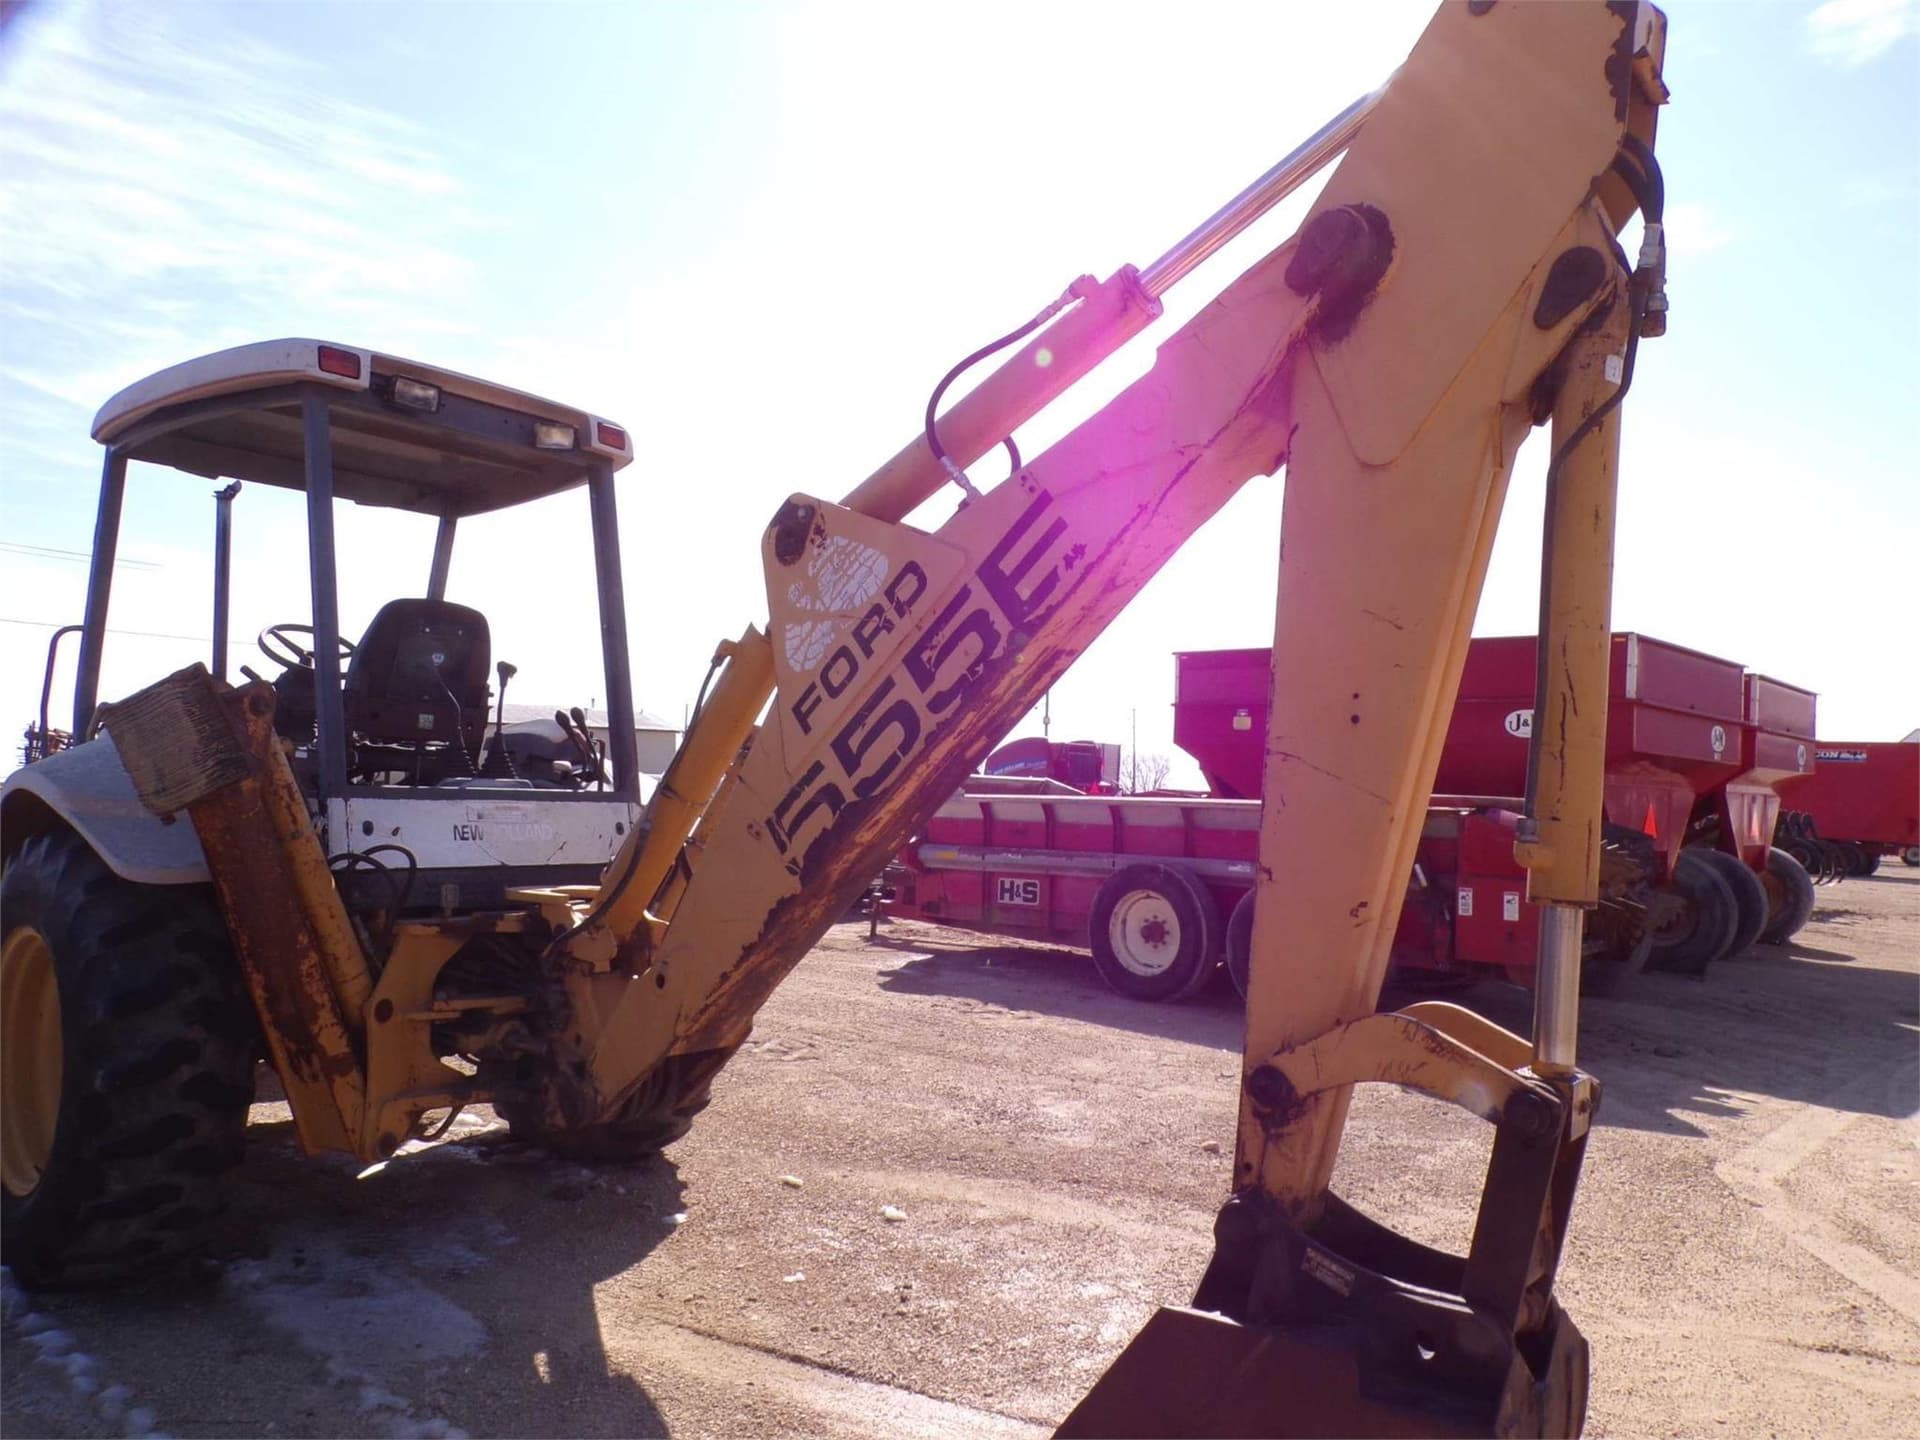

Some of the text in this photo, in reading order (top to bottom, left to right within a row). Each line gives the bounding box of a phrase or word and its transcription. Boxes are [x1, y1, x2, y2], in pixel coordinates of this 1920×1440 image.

[791, 560, 928, 735] FORD
[765, 489, 1068, 876] 555E
[1509, 713, 1532, 732] J&
[453, 824, 484, 841] NEW
[1000, 879, 1038, 903] H&S
